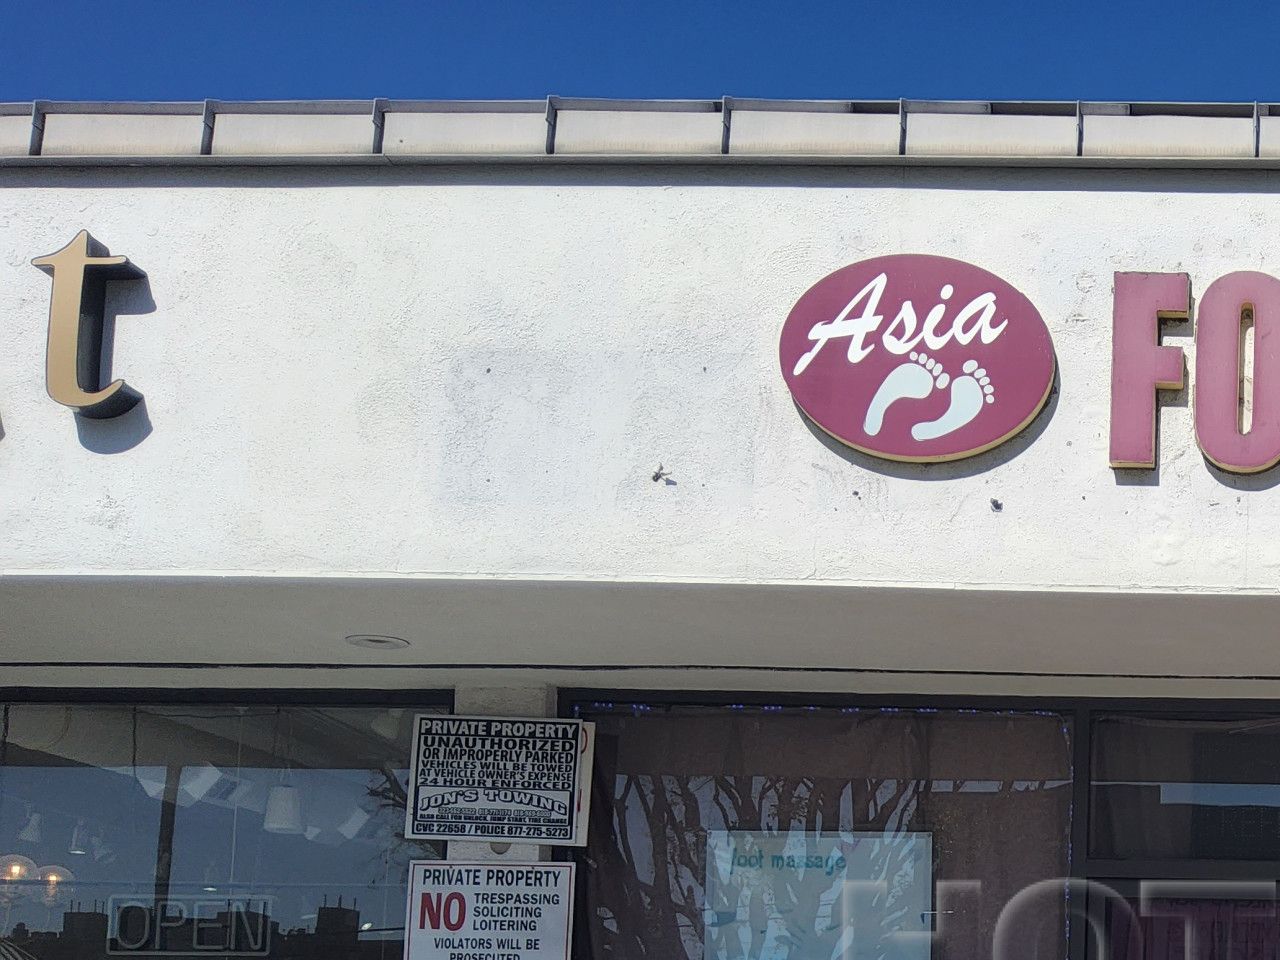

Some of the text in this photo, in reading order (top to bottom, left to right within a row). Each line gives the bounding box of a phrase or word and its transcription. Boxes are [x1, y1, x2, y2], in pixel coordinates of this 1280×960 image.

[793, 272, 1008, 376] Asia
[421, 720, 577, 738] PRIVATE PROPERTY
[423, 736, 574, 751] UNAUTHORIZED
[423, 748, 573, 764] OR IMPROPERLY PARKED
[422, 760, 572, 772] VEHICLES WILL BE TOWED
[420, 769, 572, 781] AT VEHICLE OWNER'S EXPENSE
[443, 778, 486, 786] HOUR
[492, 780, 571, 789] ENFORCED
[420, 790, 479, 811] JON'S
[484, 789, 568, 816] TOWING
[416, 823, 434, 832] CVC
[436, 824, 466, 833] 22658
[475, 825, 505, 835] POLICE
[507, 826, 568, 837] 877-275-5273
[771, 851, 847, 876] massage
[423, 869, 561, 887] PRIVATE PROPERTY
[474, 893, 560, 905] TRESPASSING
[419, 892, 466, 931] NO
[473, 907, 541, 918] SOLICITING
[117, 900, 263, 950] OPEN
[473, 920, 537, 931] LOITERING
[434, 938, 540, 950] VIOLATORS WILL BE
